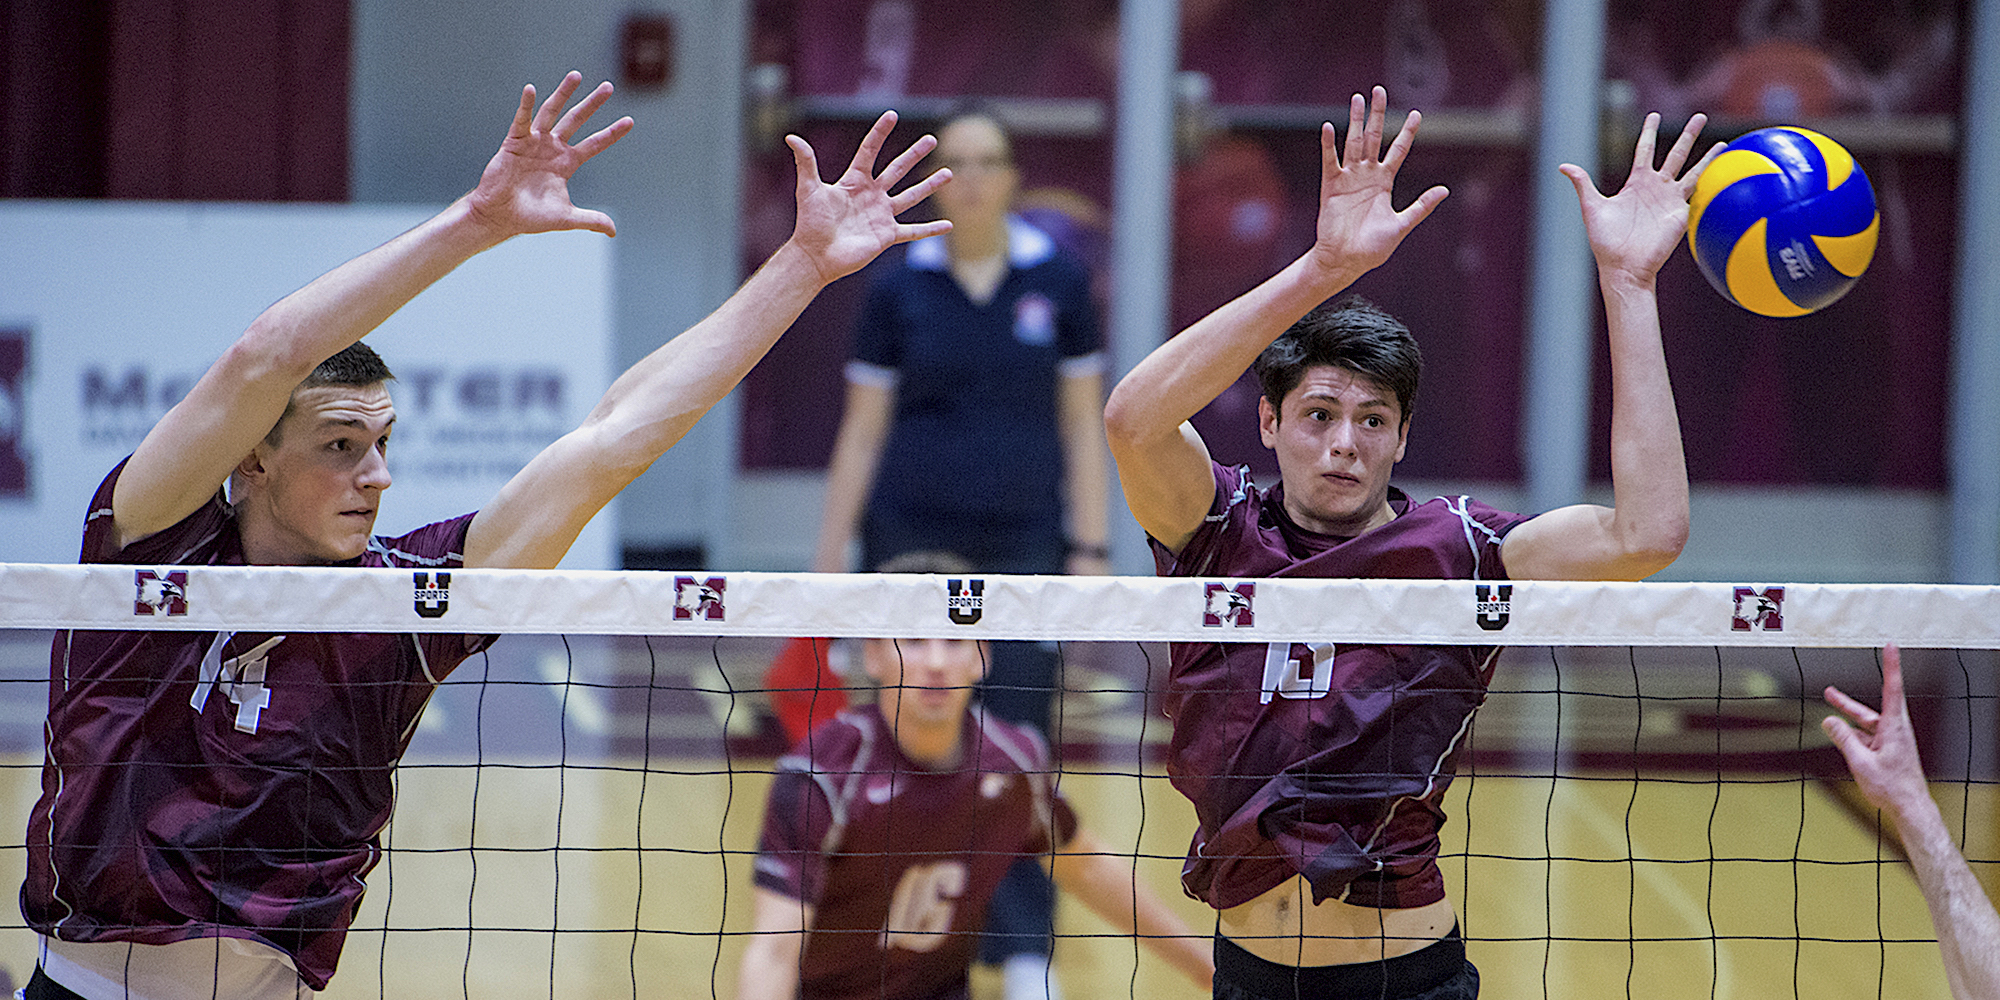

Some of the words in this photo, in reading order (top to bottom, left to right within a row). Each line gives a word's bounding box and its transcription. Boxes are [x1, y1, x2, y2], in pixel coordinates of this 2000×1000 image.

[414, 590, 449, 600] SPORTS
[948, 597, 983, 607] SPORTS
[1476, 603, 1511, 612] SPORTS
[189, 631, 287, 735] 14
